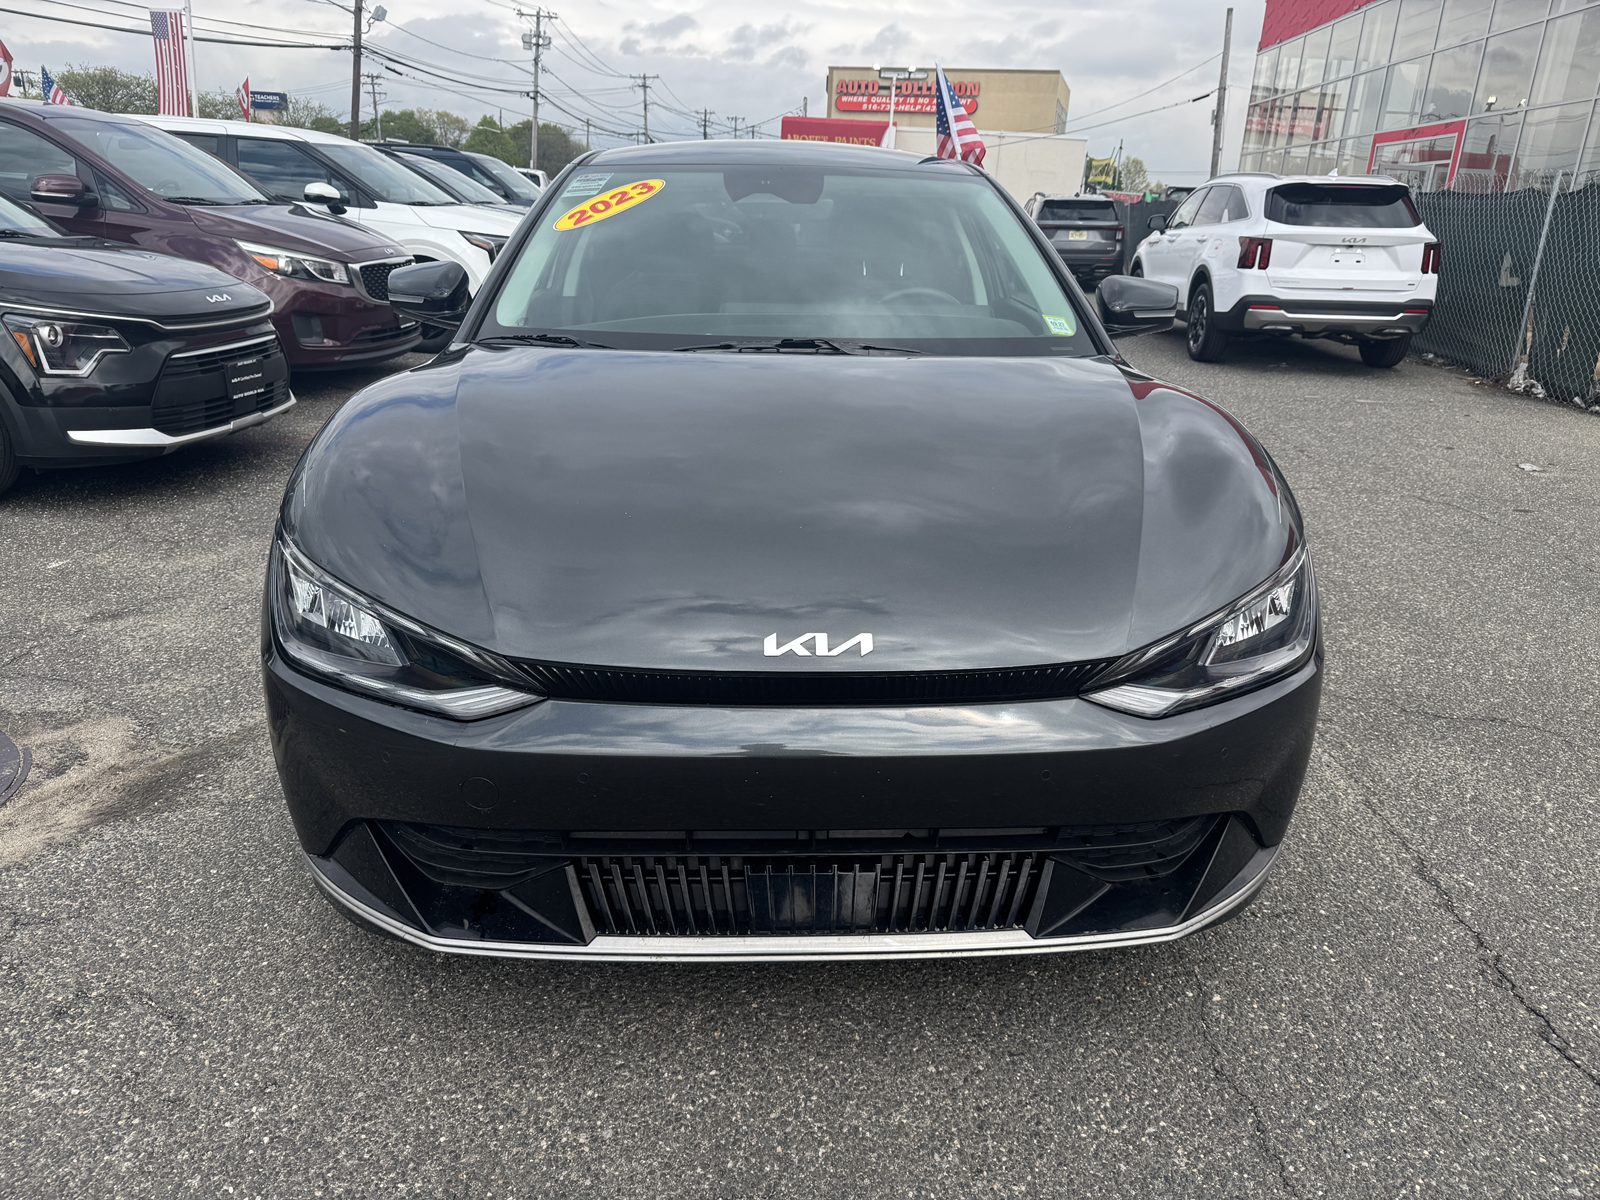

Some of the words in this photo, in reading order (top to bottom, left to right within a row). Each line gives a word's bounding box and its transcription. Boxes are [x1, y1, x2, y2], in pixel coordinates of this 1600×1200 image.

[836, 80, 879, 95] AUTO
[890, 81, 981, 97] COLLION
[841, 95, 867, 103] WHERE
[871, 96, 904, 104] QUALTY
[862, 104, 924, 112] 516-73-HELP
[834, 136, 876, 146] PAINTS
[567, 182, 657, 227] 2023
[206, 293, 232, 303] KIA
[763, 632, 874, 657] KIA
